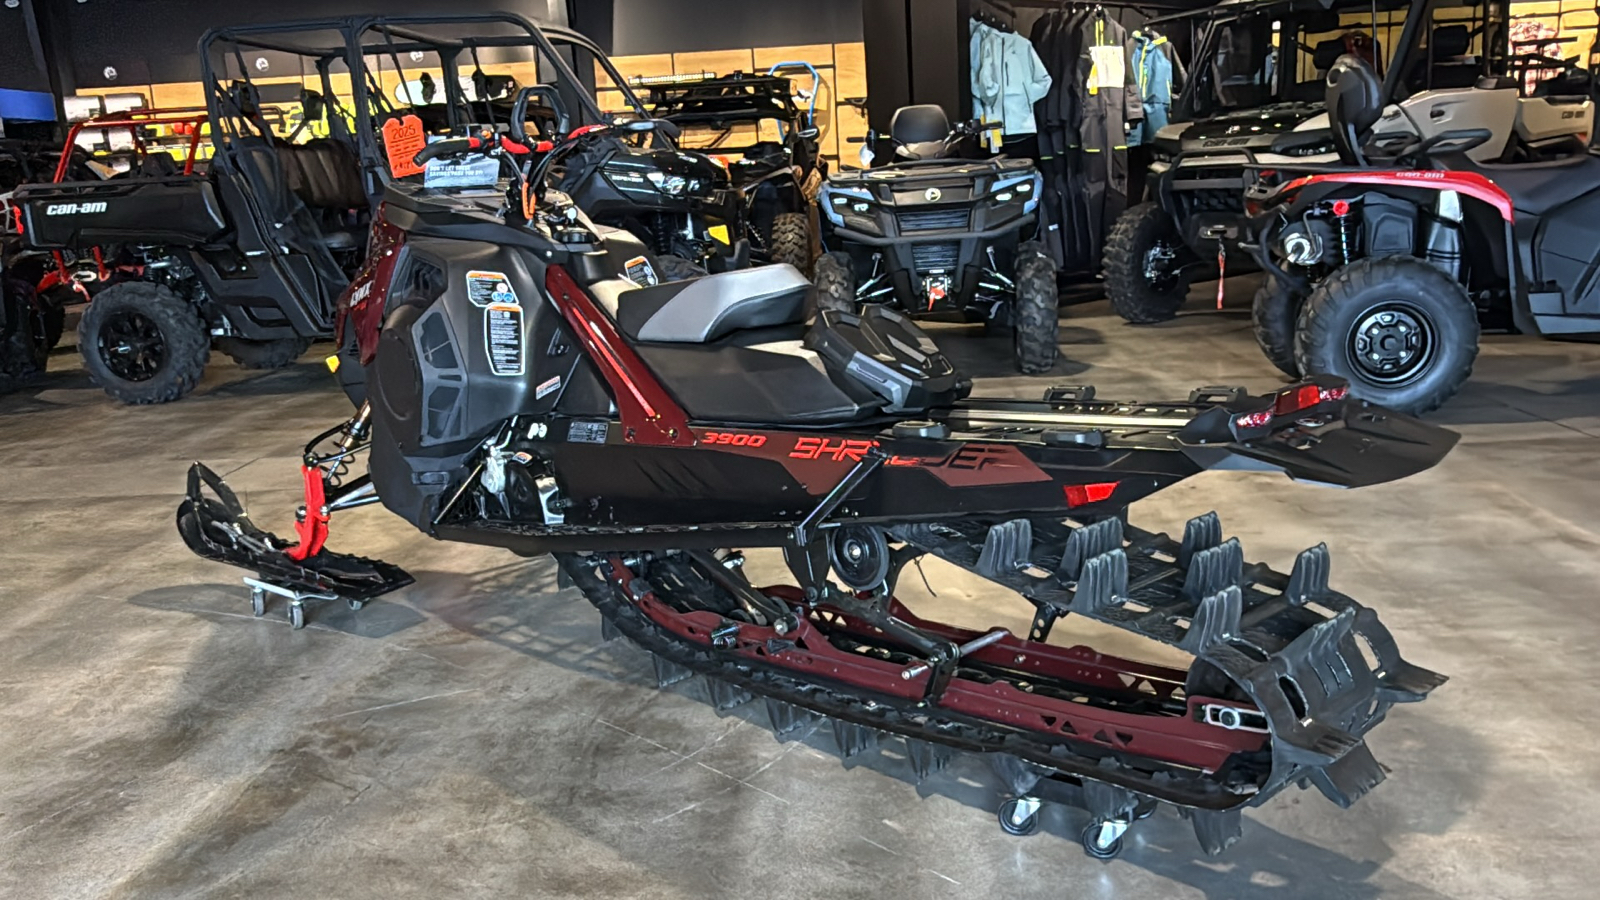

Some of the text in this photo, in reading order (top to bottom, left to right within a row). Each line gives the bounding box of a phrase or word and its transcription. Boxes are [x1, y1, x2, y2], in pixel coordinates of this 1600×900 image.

[391, 124, 416, 140] 2025
[46, 201, 107, 216] can-am
[350, 280, 373, 307] LYNX
[701, 431, 767, 447] 3900
